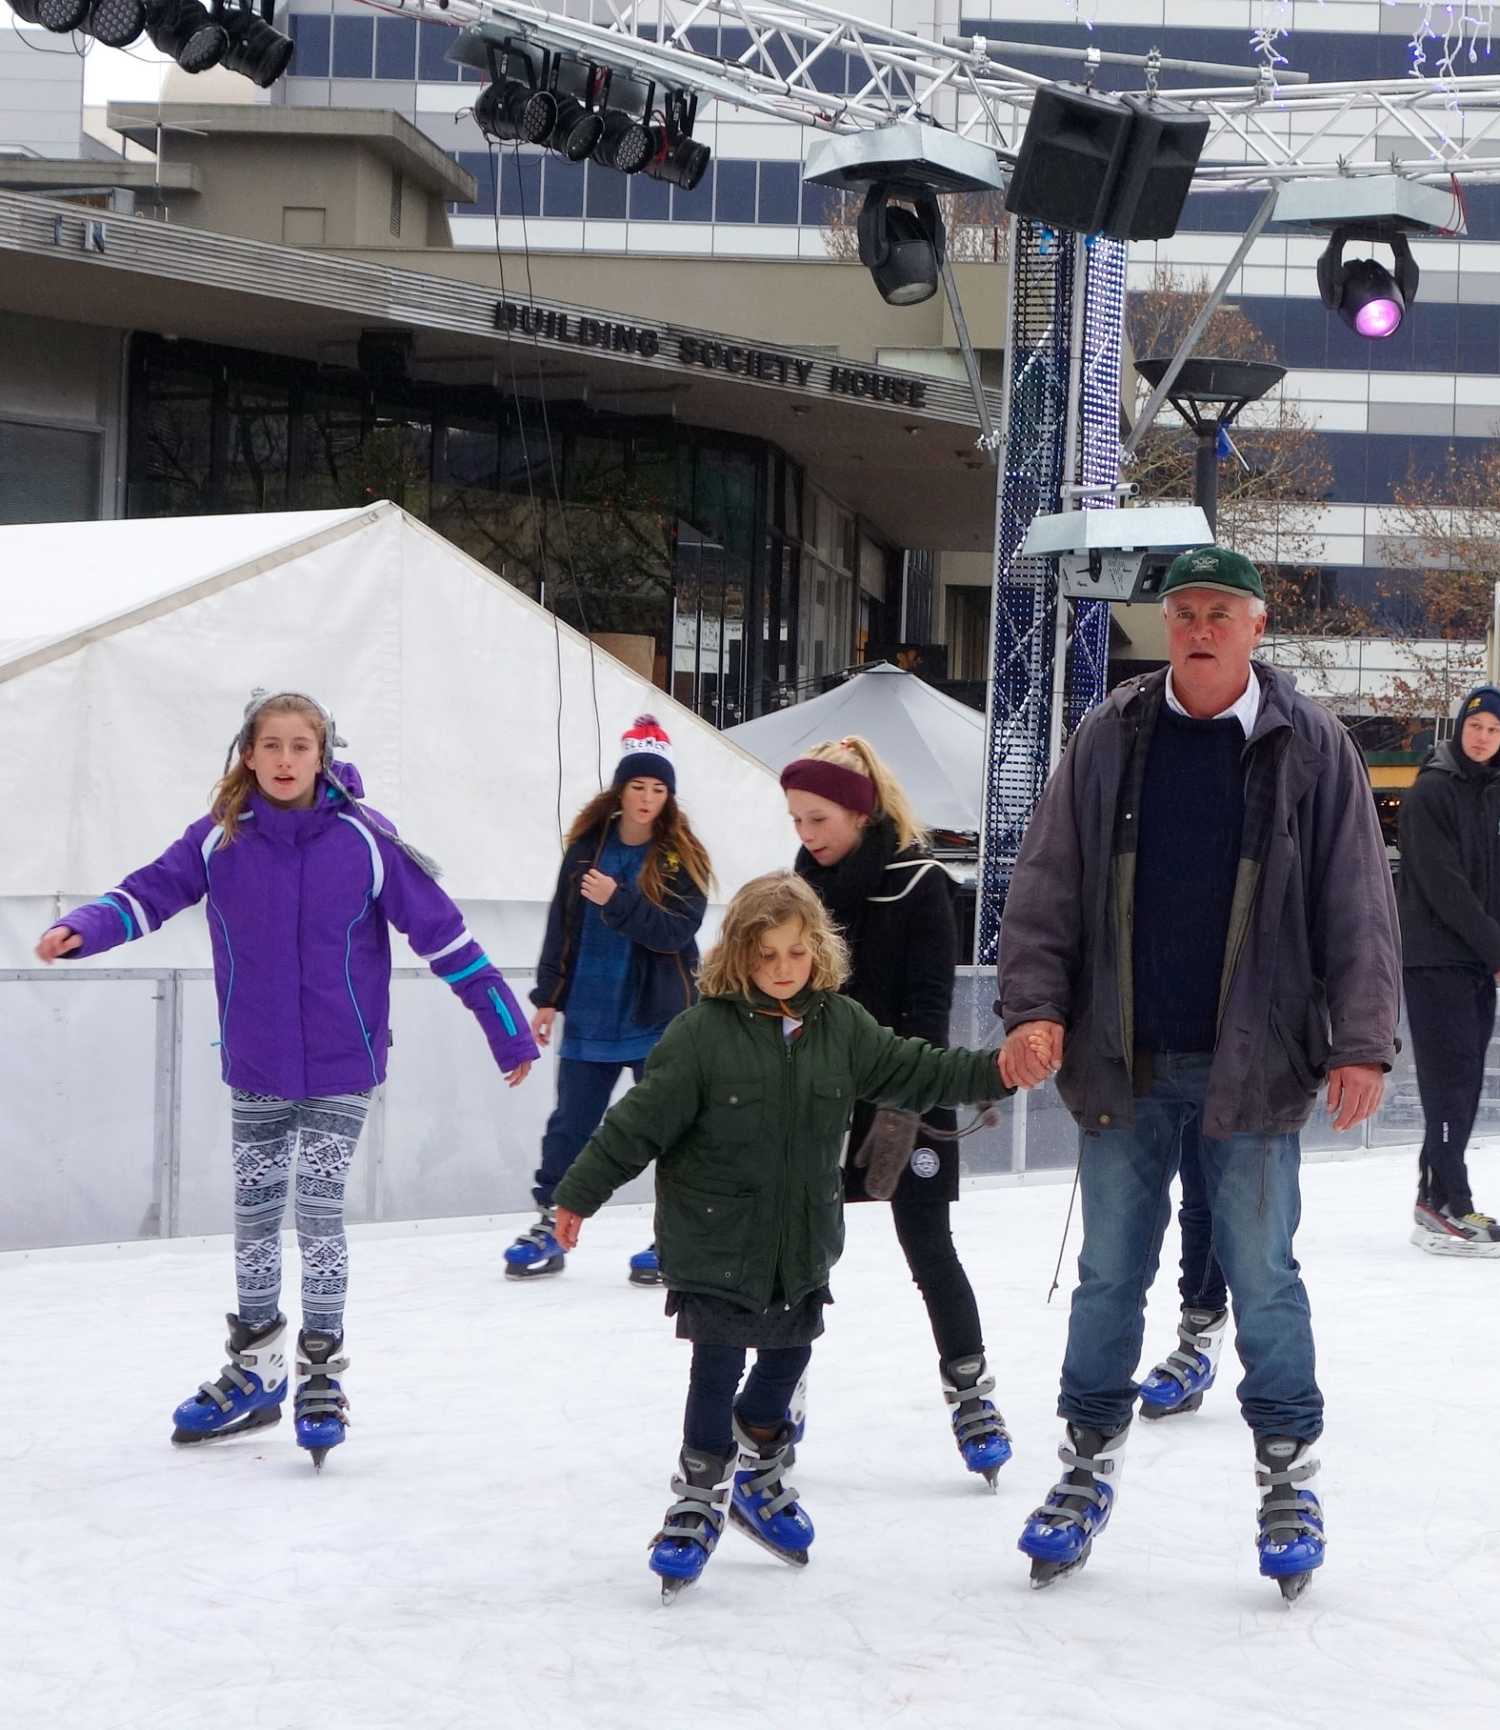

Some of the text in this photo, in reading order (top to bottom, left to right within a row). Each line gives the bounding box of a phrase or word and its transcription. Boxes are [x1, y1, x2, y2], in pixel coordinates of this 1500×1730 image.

[494, 300, 928, 408] BUILDING SOCIETY HOUSE
